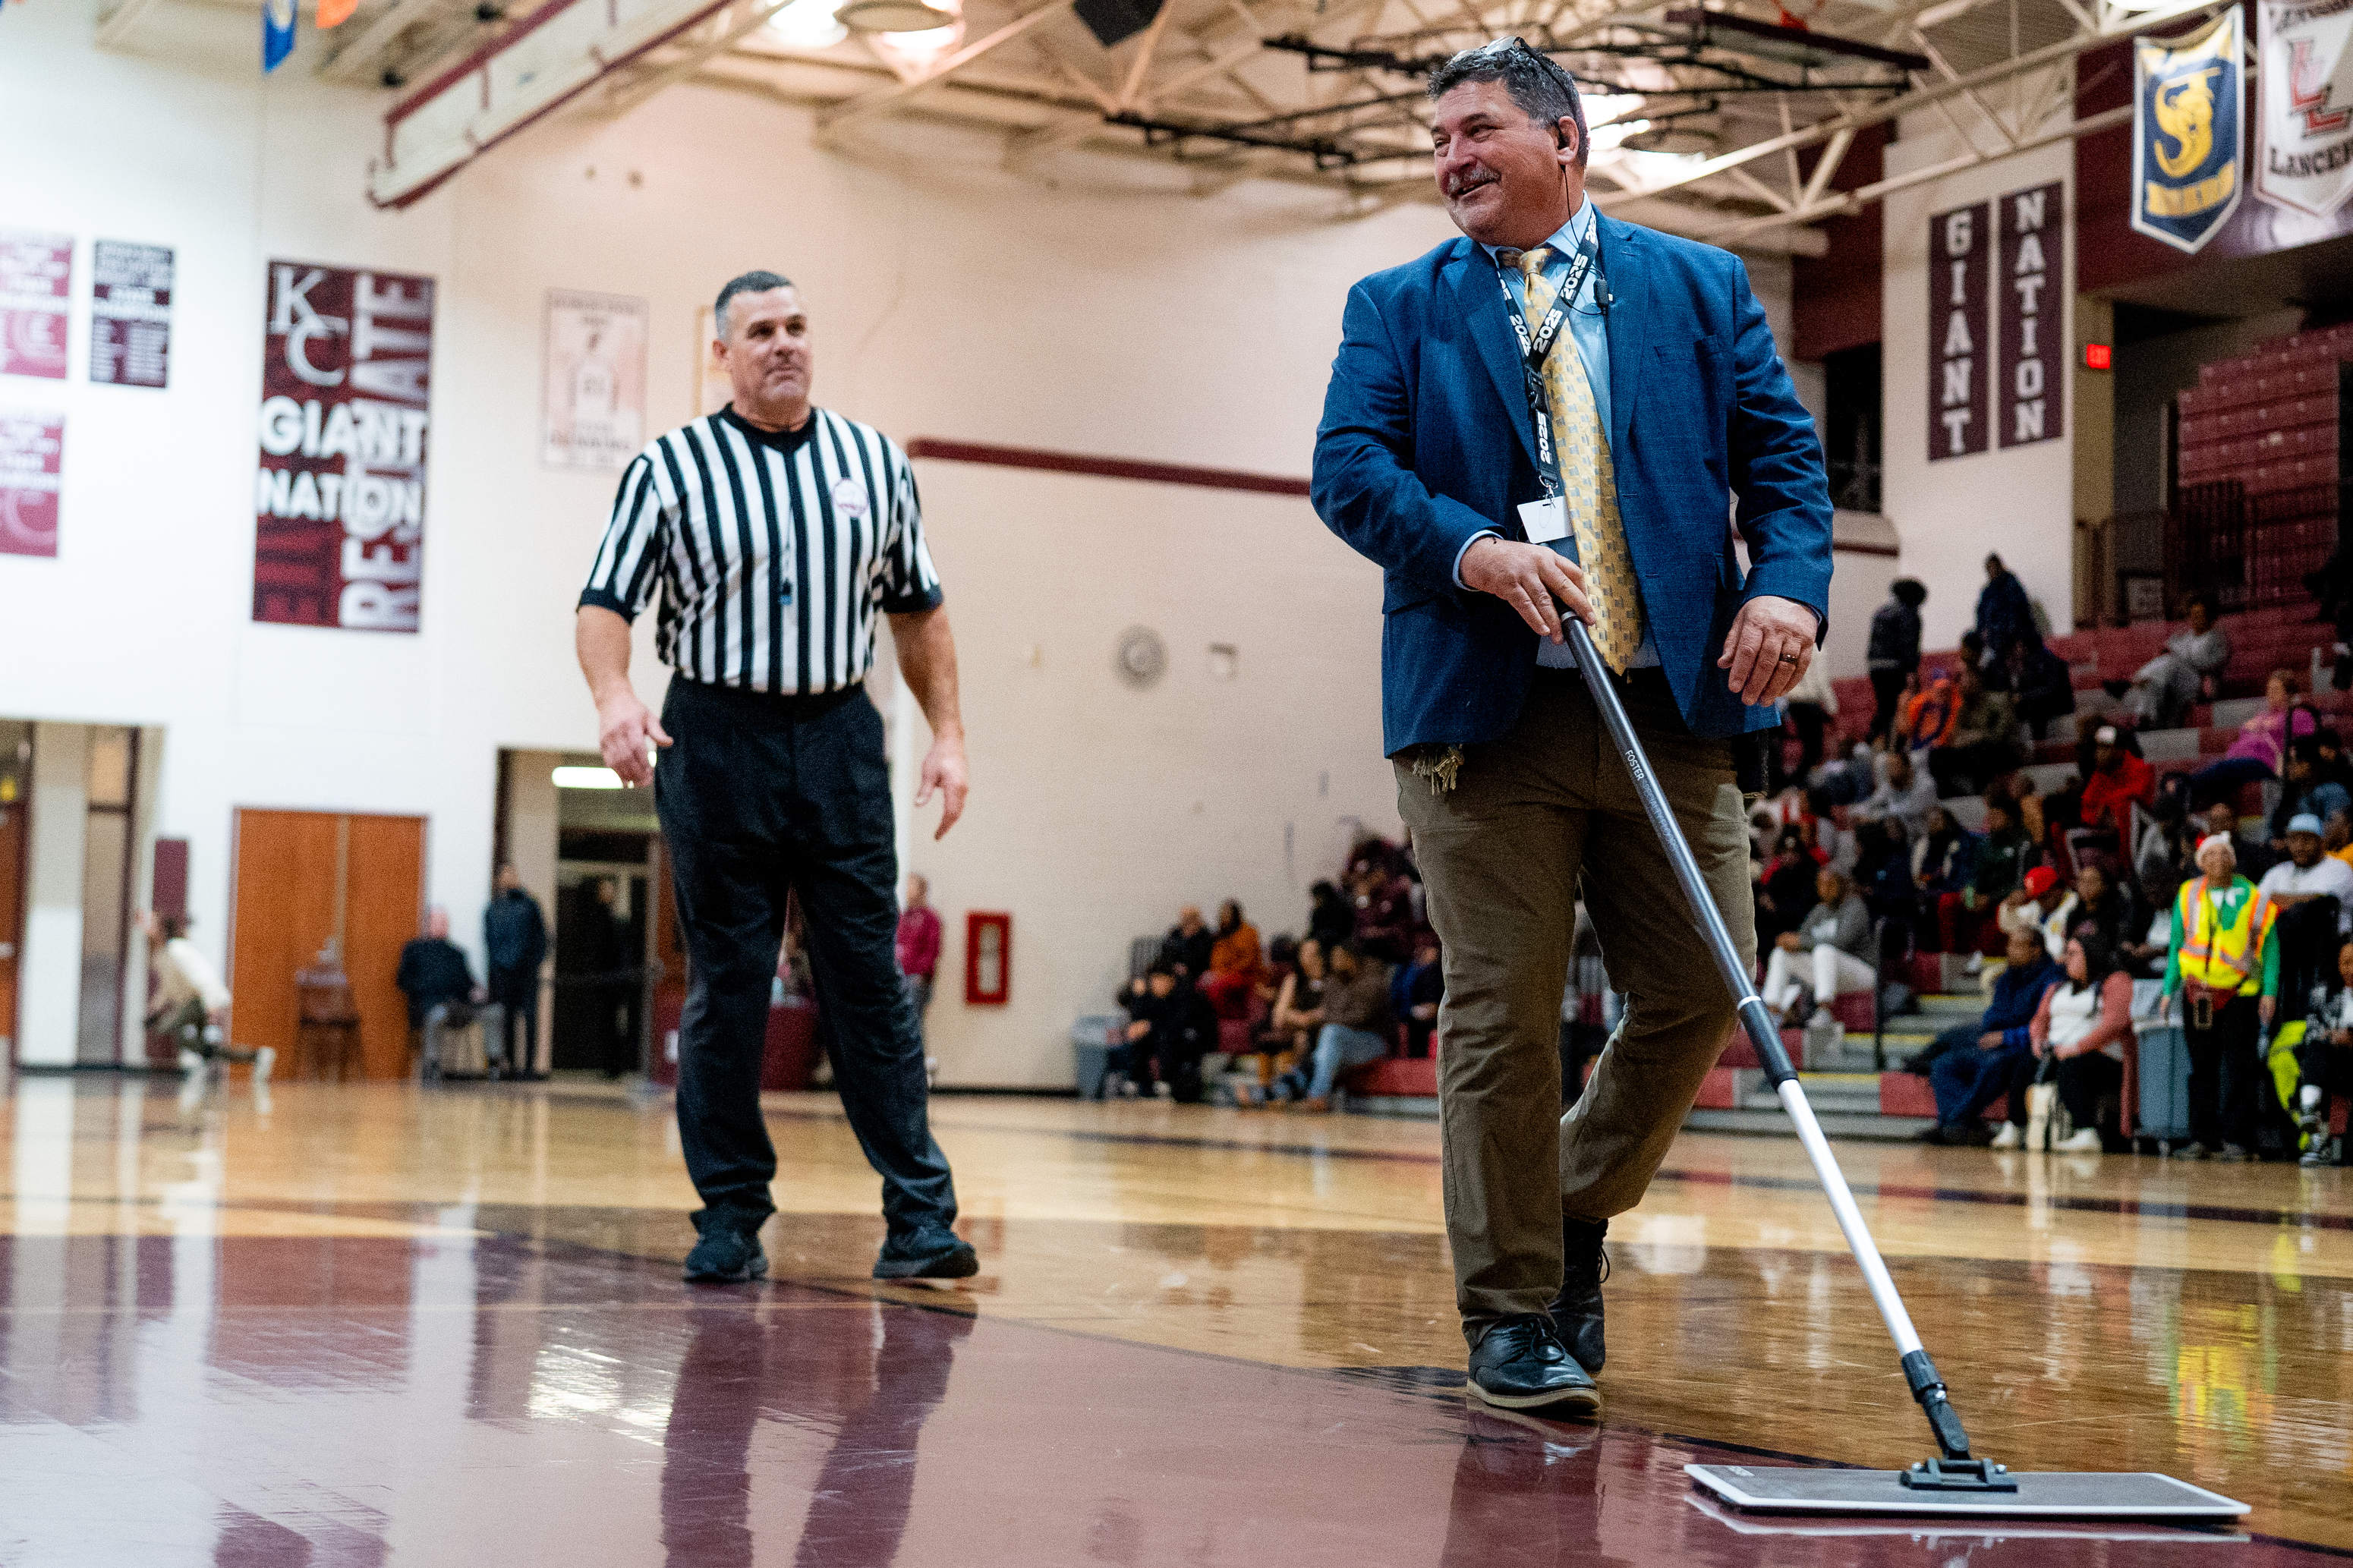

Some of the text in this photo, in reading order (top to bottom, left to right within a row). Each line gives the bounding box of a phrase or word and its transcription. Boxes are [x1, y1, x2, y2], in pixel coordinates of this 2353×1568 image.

[1560, 253, 1589, 300] 2025
[1533, 308, 1564, 353] 2025
[1940, 209, 1973, 454] GIANT
[2014, 190, 2047, 442] NATION
[260, 395, 428, 466] GIANT
[340, 272, 437, 630] RESATE
[1537, 411, 1551, 464] 2025
[256, 468, 424, 528] NATION
[1624, 750, 1645, 781] FOSTER
